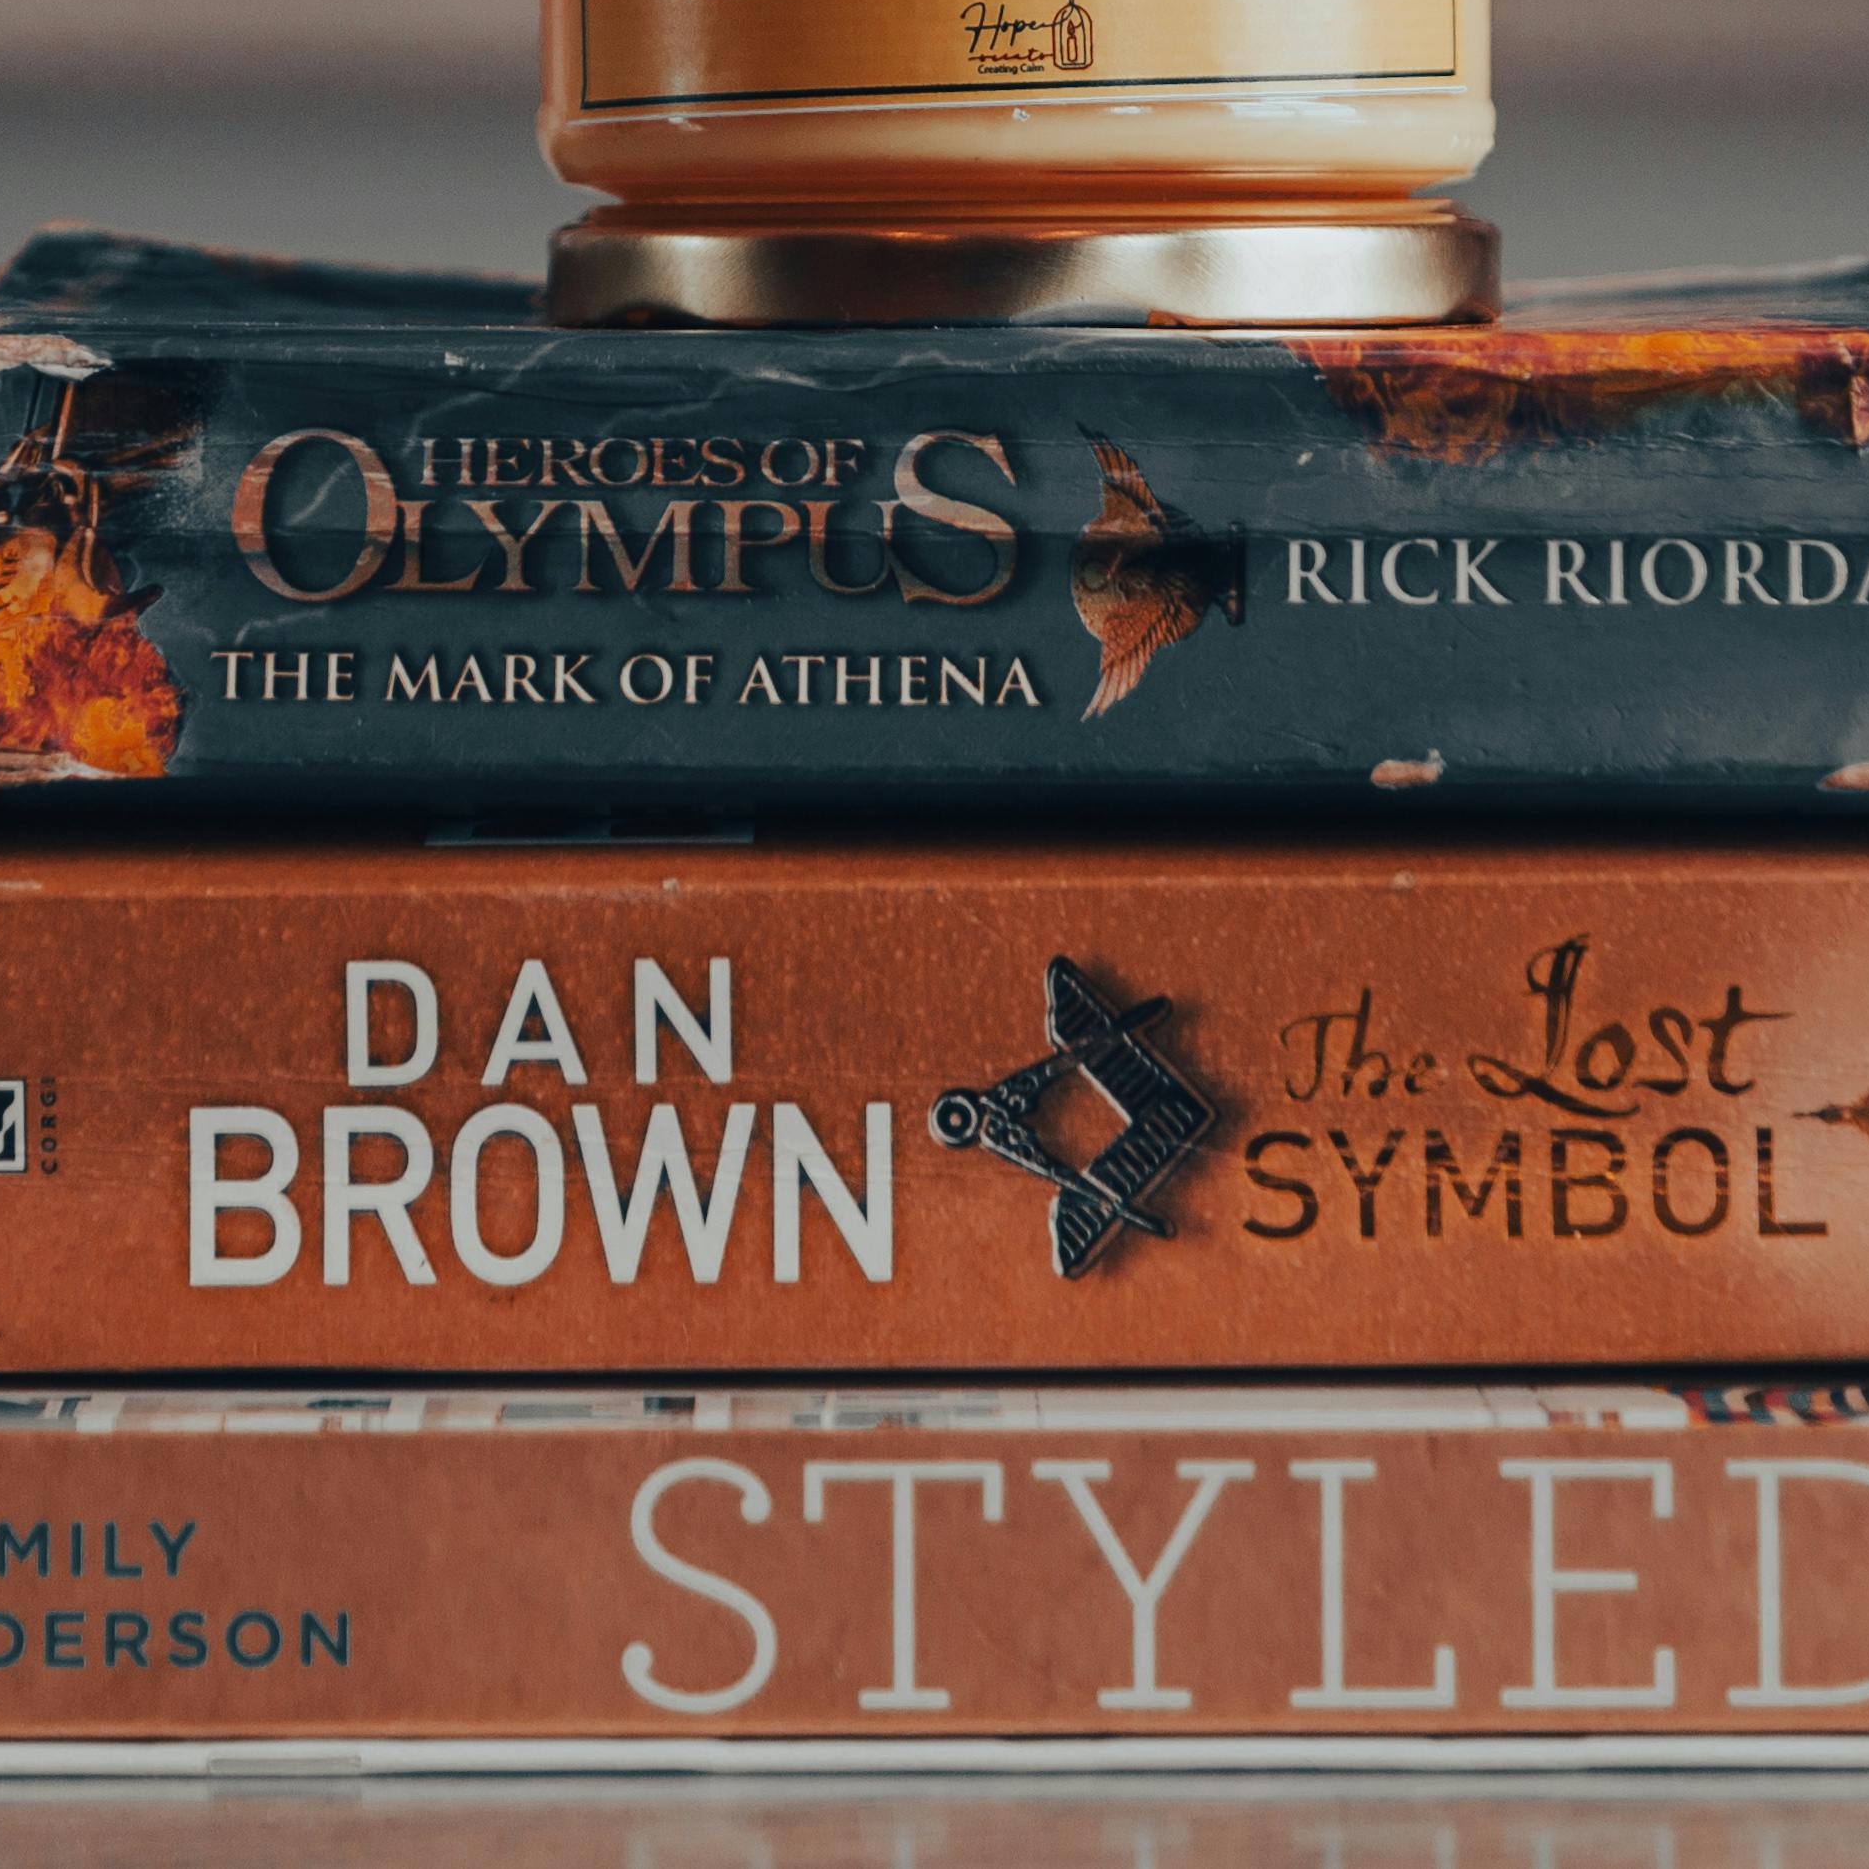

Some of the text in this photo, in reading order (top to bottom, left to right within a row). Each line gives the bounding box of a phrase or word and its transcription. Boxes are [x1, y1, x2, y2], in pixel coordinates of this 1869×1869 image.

[960, 2, 1052, 53] Hope
[978, 63, 1044, 75] Creating Calm
[421, 434, 868, 489] HEROES OF
[231, 427, 1020, 608] OLYMPUS
[1282, 536, 1514, 608] RICK
[210, 650, 1043, 709] THE MARK OF ATHENA
[343, 956, 732, 1088] DAN
[1278, 930, 1797, 1119] The Lost
[40, 1076, 58, 1175] CORGI
[188, 1102, 894, 1288] BROWN
[1240, 1126, 1830, 1240] SYMBOL
